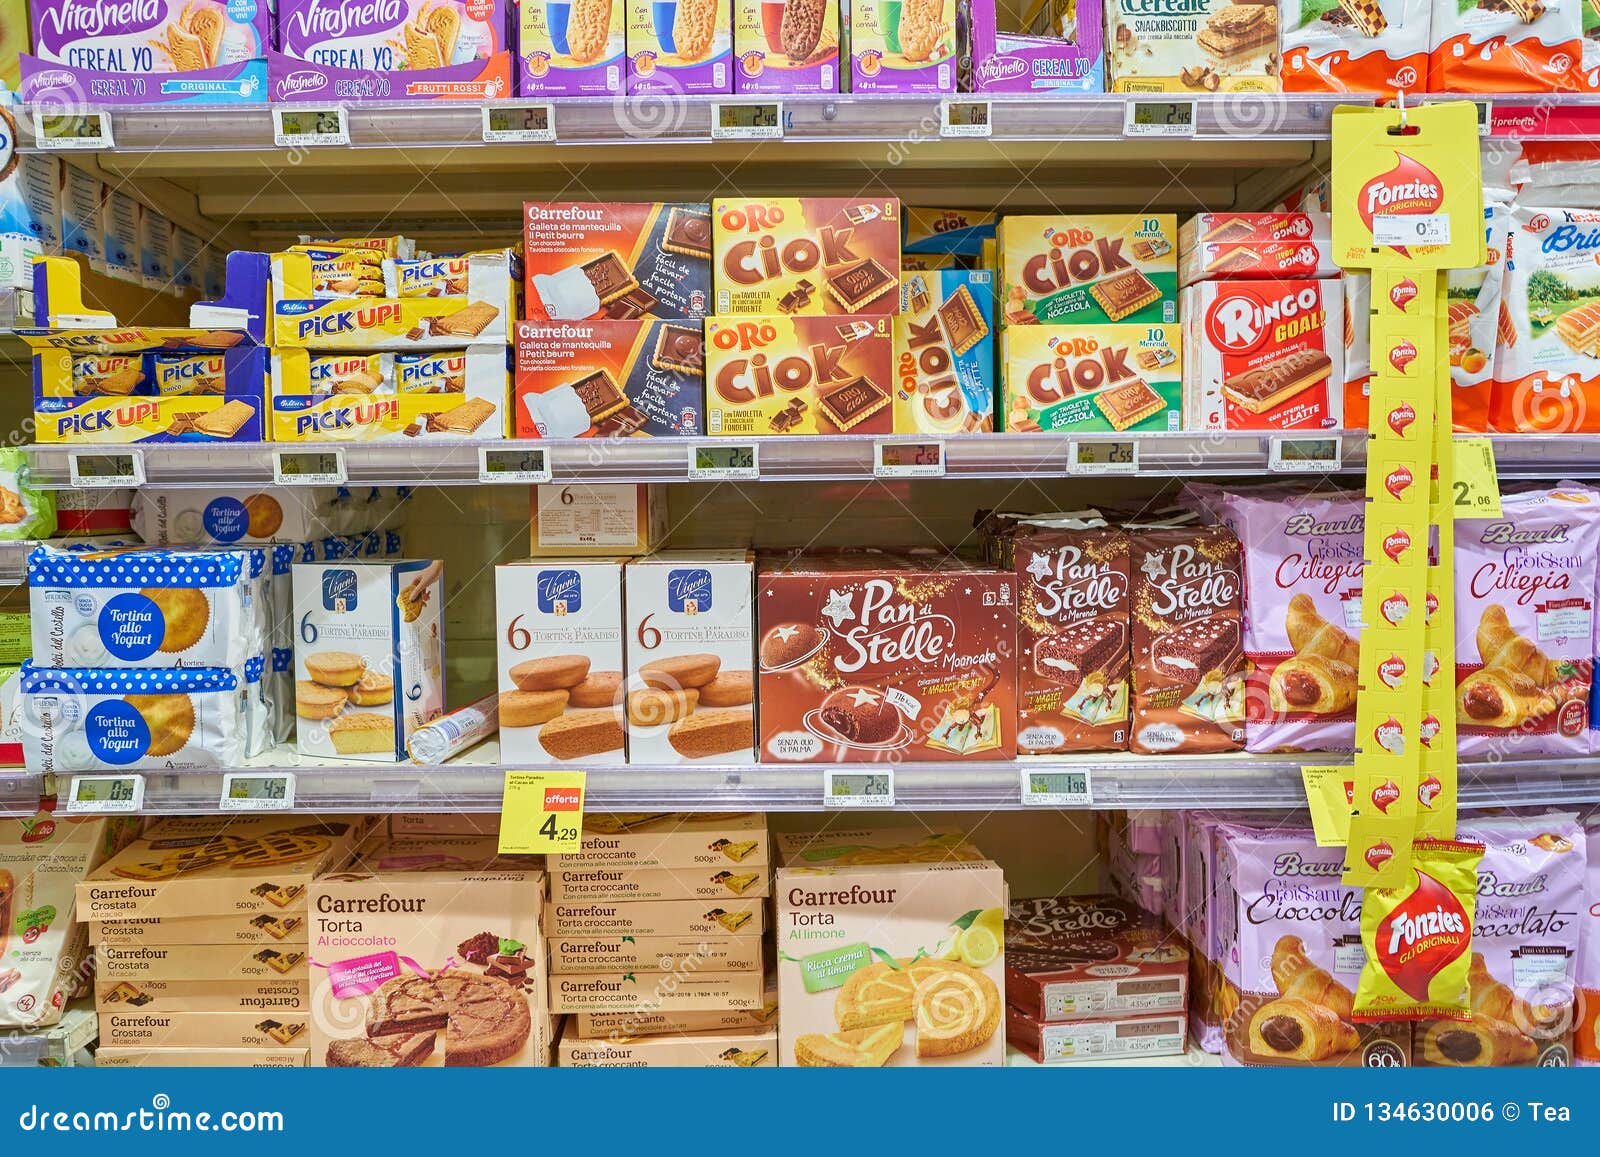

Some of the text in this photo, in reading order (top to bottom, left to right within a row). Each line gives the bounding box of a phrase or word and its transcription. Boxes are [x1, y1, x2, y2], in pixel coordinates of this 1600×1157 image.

[228, 5, 256, 13] FERMENTI
[466, 4, 493, 12] FERMENTI
[1135, 21, 1197, 32] SNACKBISCOTTO
[133, 48, 152, 71] YO
[373, 49, 392, 70] YO
[1032, 59, 1091, 76] CEREAL YO
[91, 79, 145, 96] CEREAL YO
[336, 80, 390, 96] CEREAL YO
[454, 84, 481, 92] ROSSI
[1368, 179, 1438, 214] Fonzies
[529, 207, 603, 220] Carrefour
[560, 223, 621, 232] de mantequilla
[1142, 219, 1159, 231] 10
[741, 291, 771, 299] TAVOLETTA
[357, 304, 401, 328] UP!
[1048, 300, 1090, 320] NOCCIOLA
[1216, 288, 1317, 350] RINGO
[519, 325, 593, 338] Carrefour
[1275, 310, 1326, 344] GOAL!
[1147, 329, 1164, 341] 10
[562, 342, 611, 350] mantequilla
[334, 360, 368, 375] UP!
[116, 403, 160, 425] UP!
[354, 400, 400, 425] UP!
[1290, 404, 1320, 422] LATTE
[1052, 411, 1095, 429] NOCCIOLA
[1480, 523, 1569, 545] Bauli
[1057, 546, 1110, 579] Pan di
[1171, 546, 1223, 578] Pan di
[1503, 547, 1583, 569] Croissant
[1471, 563, 1570, 605] Ciliegia
[861, 579, 932, 626] Pan di
[1036, 576, 1120, 616] Stelle
[1151, 576, 1234, 616] Stelle
[110, 609, 152, 623] Tortina
[51, 606, 65, 650] del Castello
[119, 623, 142, 633] allo
[300, 610, 318, 644] 6
[507, 613, 531, 650] 6
[637, 612, 661, 650] 6
[111, 633, 153, 648] Yogurt
[534, 631, 619, 641] TORTINE PARADISO
[664, 630, 749, 640] TORTINE PARADISO
[834, 621, 943, 673] Stelle
[943, 649, 997, 671] Mooncake
[95, 716, 136, 728] Tortina
[108, 727, 129, 738] allo
[99, 737, 140, 752] Yogurt
[545, 794, 579, 805] offerta
[54, 853, 78, 863] gocce
[587, 850, 636, 859] croccante
[563, 871, 623, 882] Carrefour
[90, 886, 157, 899] Carrefour
[563, 882, 639, 892] Torta croccante
[789, 885, 897, 906] Carrefour
[91, 900, 137, 910] Crostata
[316, 894, 426, 913] Carrefour
[1027, 899, 1087, 916] Pan
[556, 906, 616, 917] Carrefour
[318, 919, 362, 932] Torta
[557, 918, 633, 927] Torta croccante
[790, 912, 834, 926] Torta
[1024, 912, 1120, 935] Stelle
[102, 927, 144, 935] Crostata
[789, 929, 845, 940] Al limone
[1389, 905, 1465, 954] Fonzies
[317, 936, 397, 946] Al cioccolato
[560, 942, 621, 953] Carrefour
[106, 948, 167, 959] Carrefour
[1399, 936, 1459, 964] GLI ORIGINALI
[561, 955, 637, 963] Torta croccante
[834, 950, 864, 964] crema
[108, 961, 150, 970] Crostata
[828, 963, 856, 976] limone
[257, 987, 300, 996] Crostata
[561, 980, 622, 992] Carrefour
[240, 997, 300, 1008] Carrefour
[561, 993, 637, 1002] Torta croccante
[111, 1016, 170, 1027] Carrefour
[590, 1019, 616, 1027] Torta
[112, 1029, 152, 1037] Crostata
[571, 1049, 632, 1061] Carrefour
